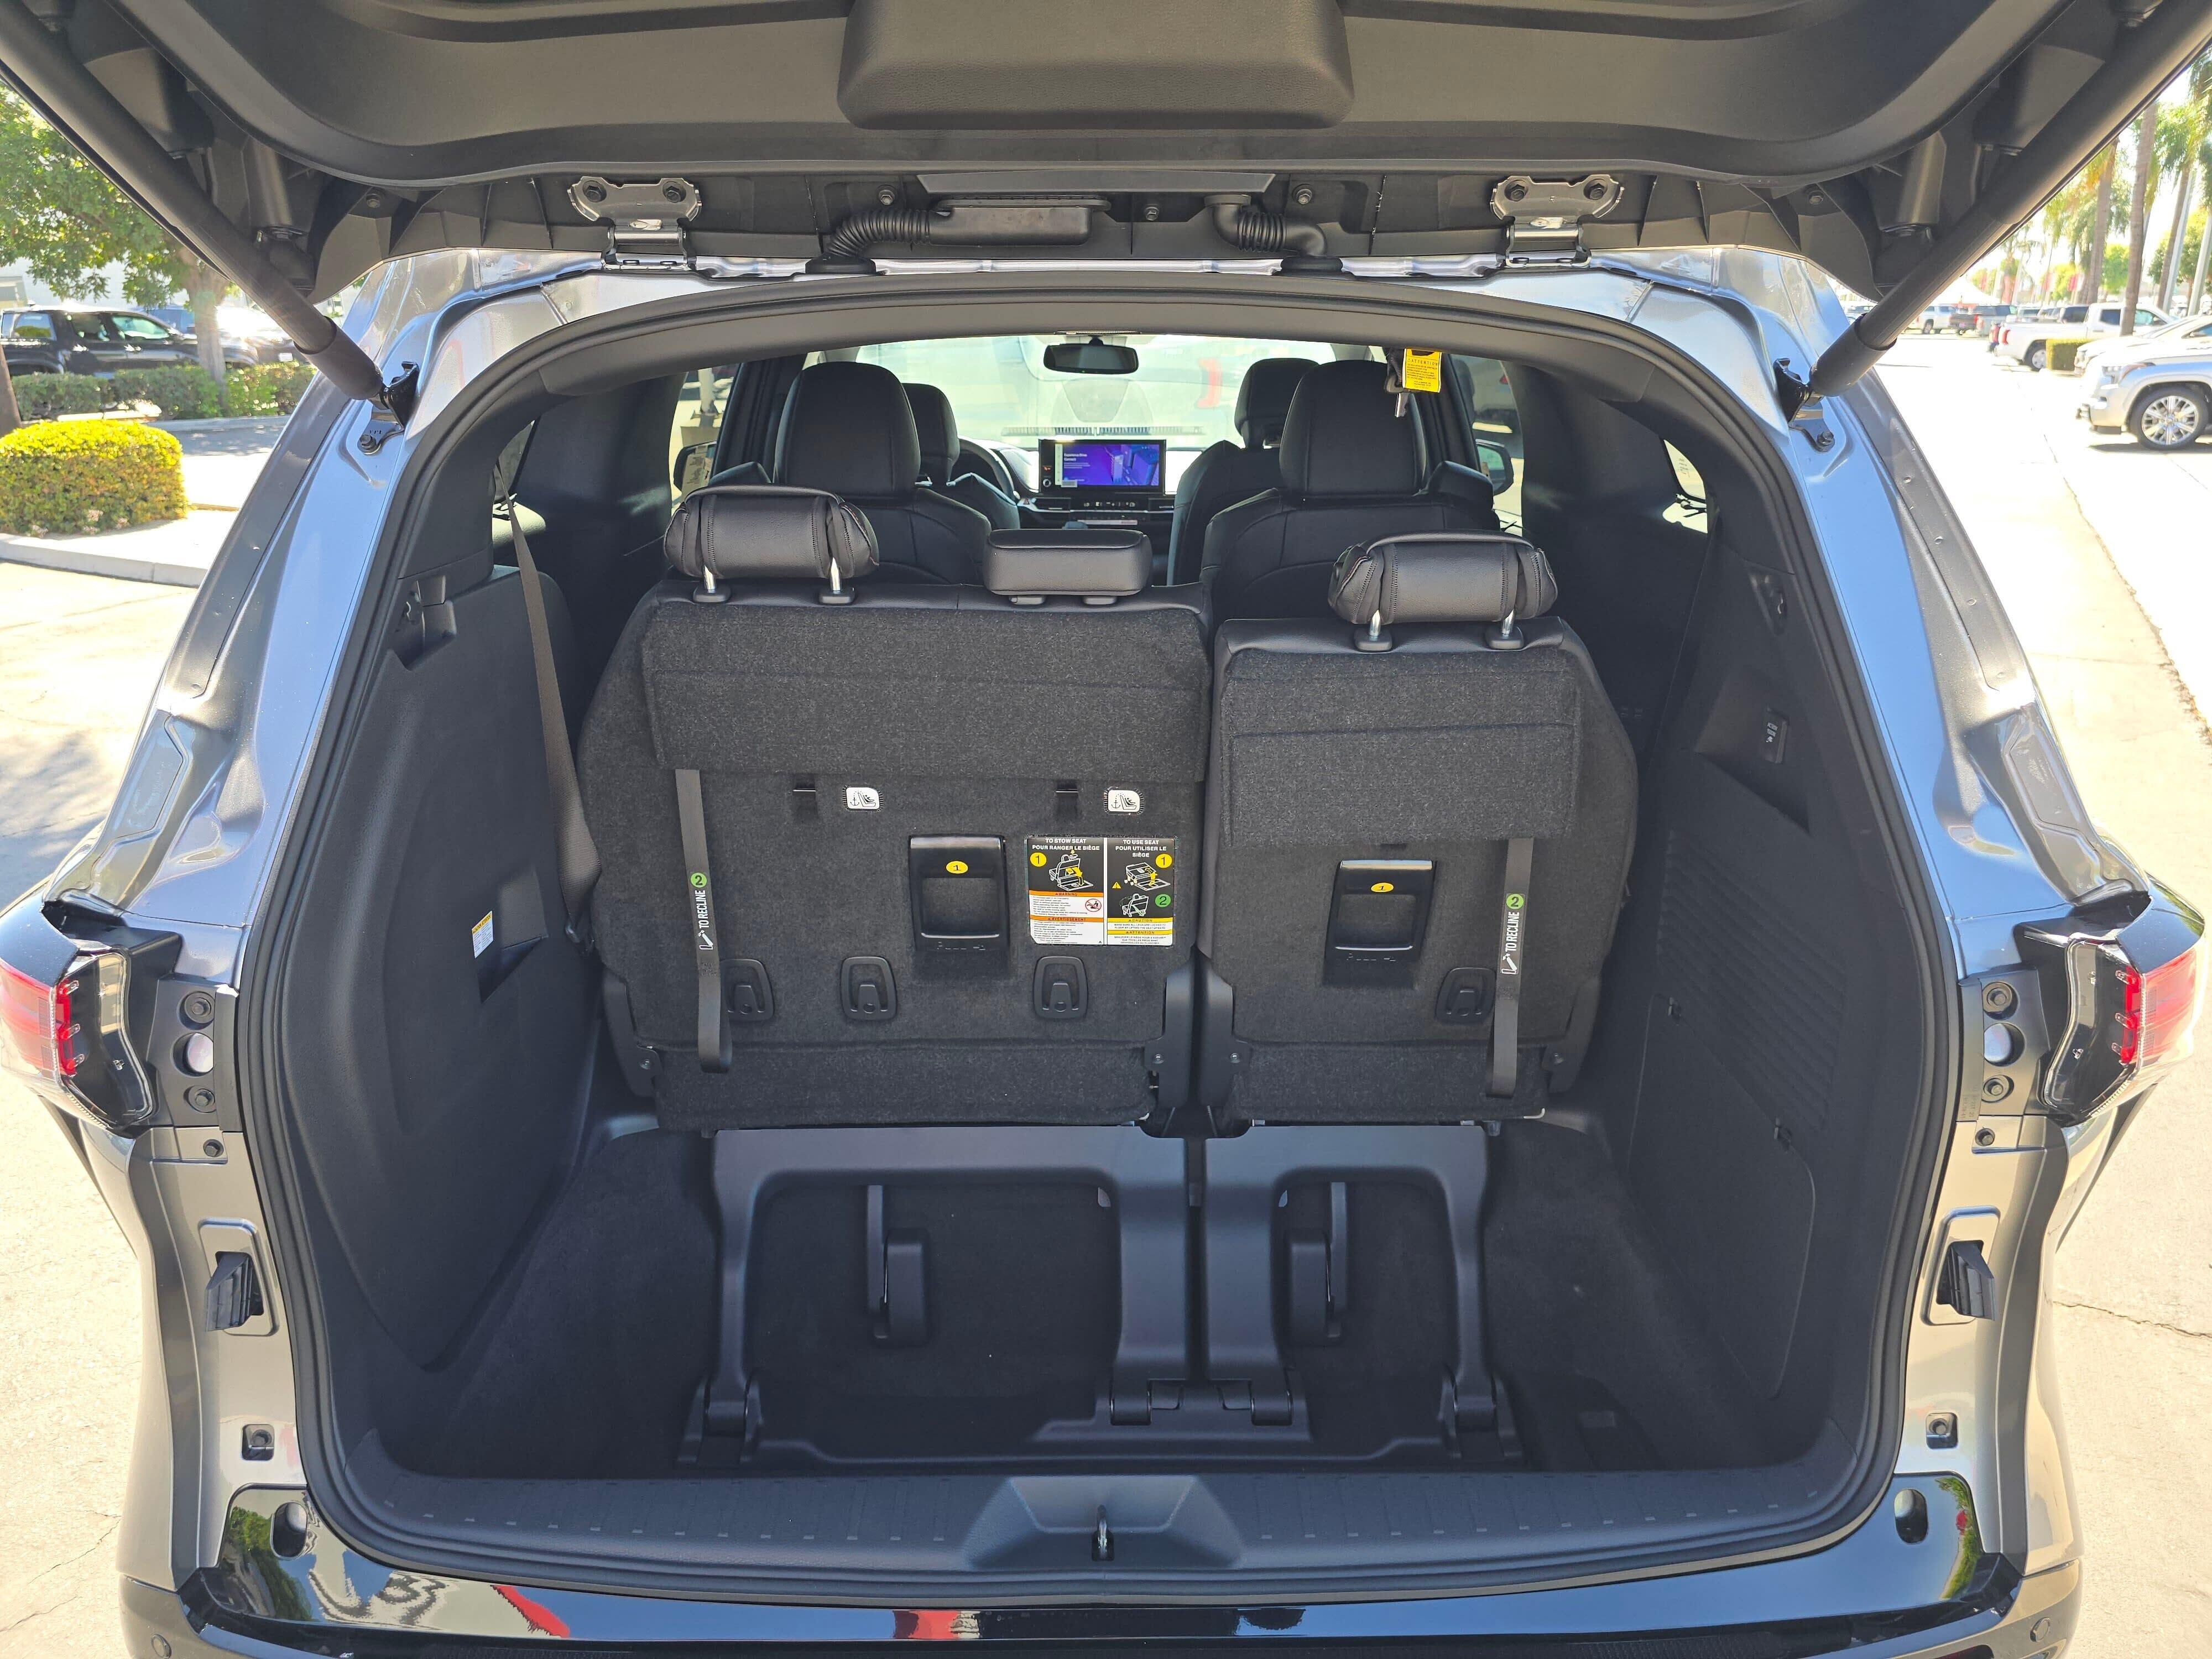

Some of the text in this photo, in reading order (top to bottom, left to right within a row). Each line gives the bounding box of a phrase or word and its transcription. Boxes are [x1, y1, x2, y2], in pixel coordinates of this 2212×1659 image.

[1035, 855, 1040, 864] 1
[1161, 856, 1165, 866] 1
[695, 875, 703, 885] 2
[1159, 896, 1167, 905] 2
[1510, 896, 1519, 907] 2
[695, 890, 709, 929] TO RECLINE
[1505, 911, 1520, 952] TO RECLINE
